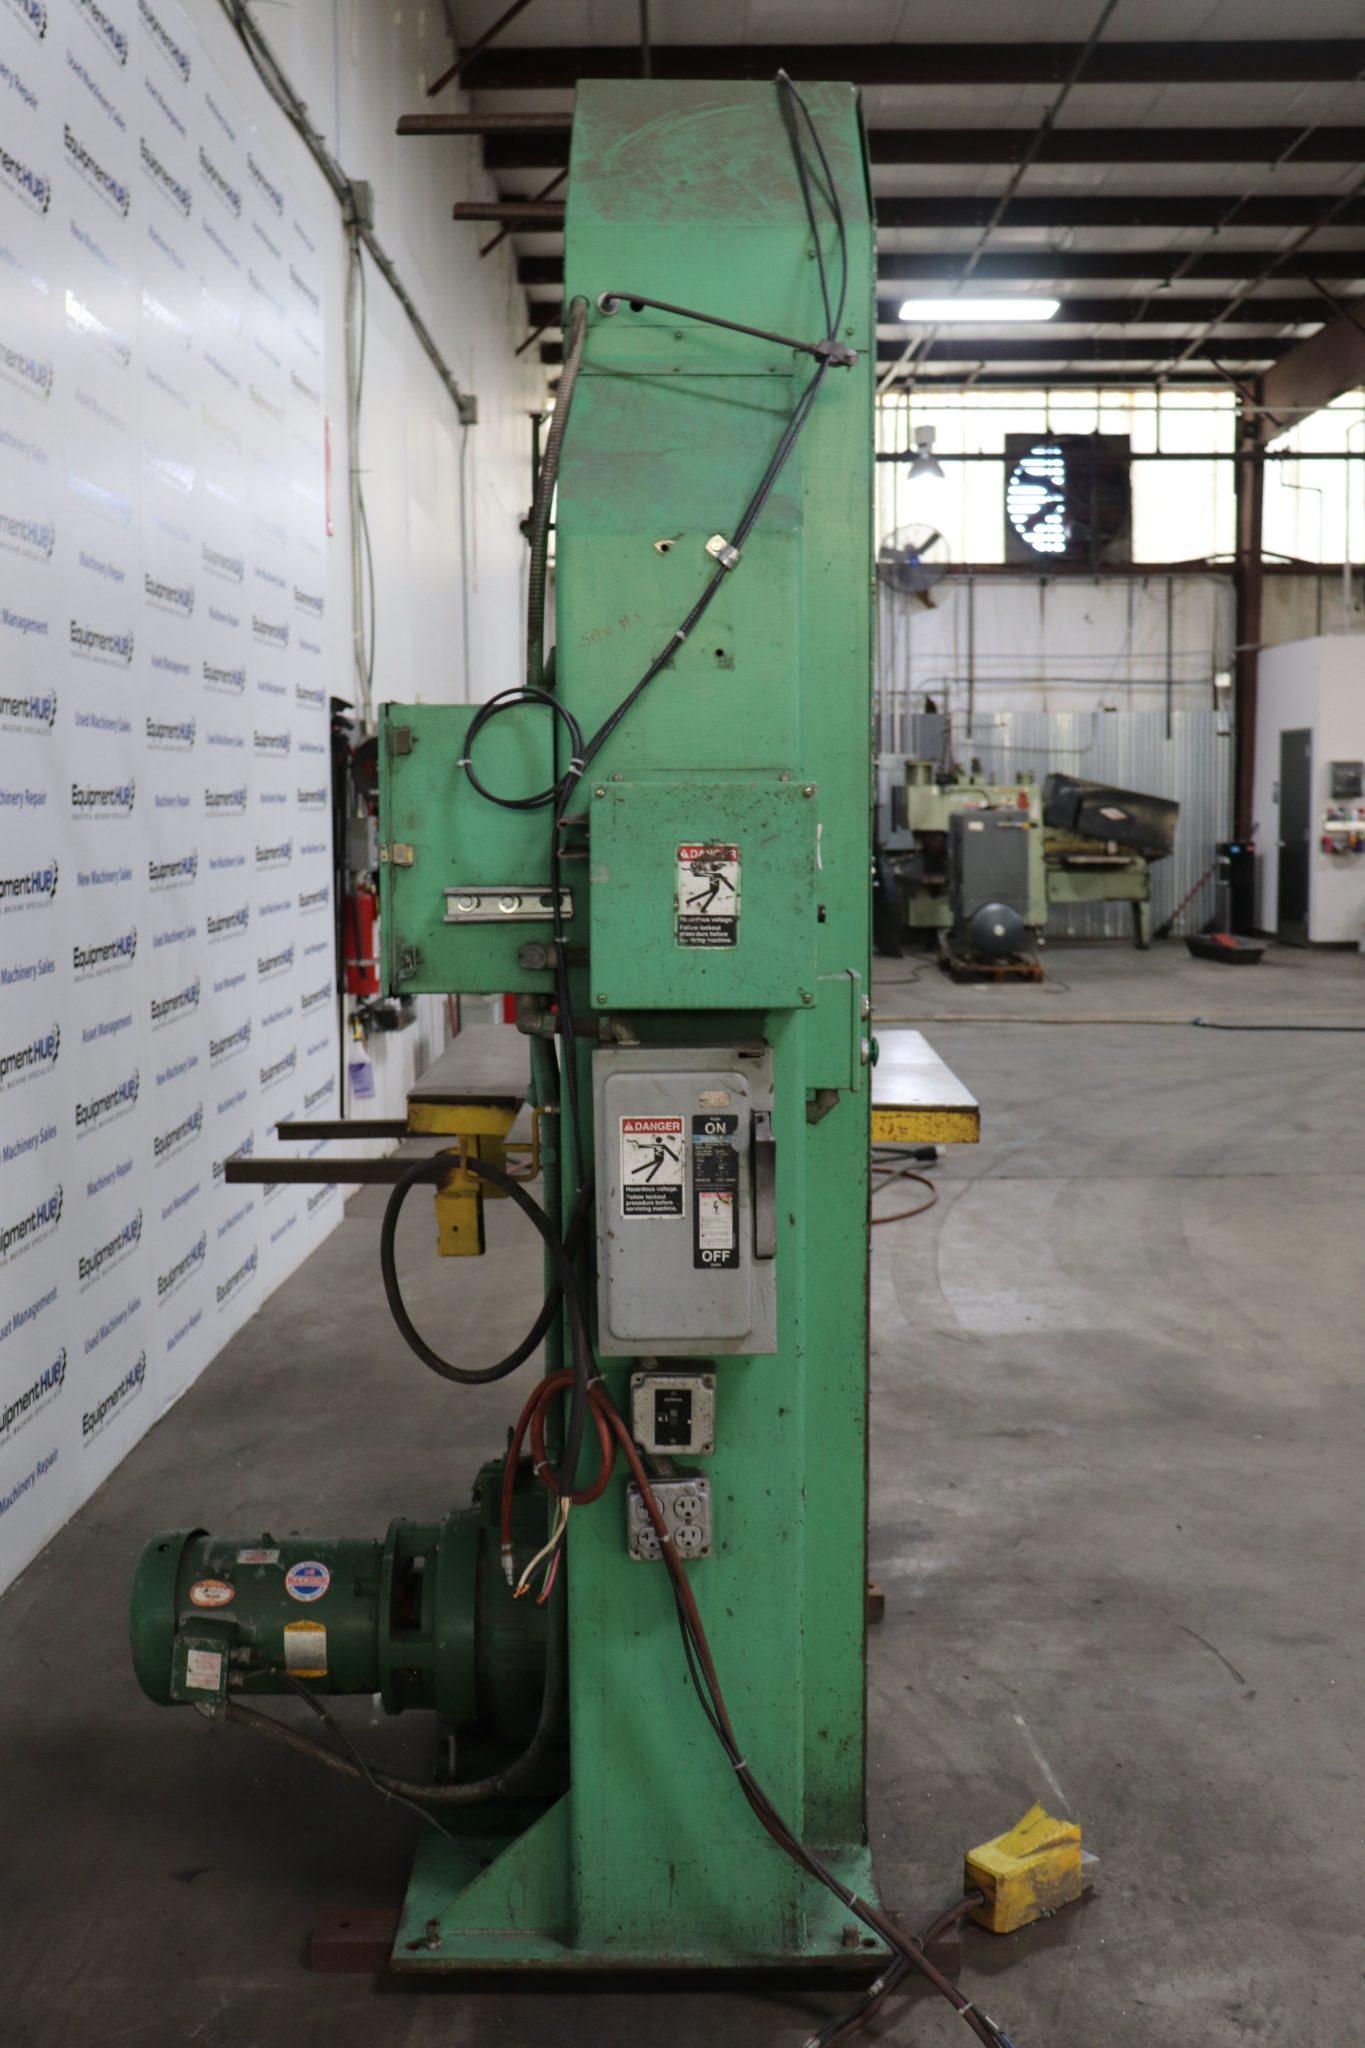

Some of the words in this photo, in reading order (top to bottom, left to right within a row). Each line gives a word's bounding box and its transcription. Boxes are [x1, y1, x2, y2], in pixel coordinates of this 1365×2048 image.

[70, 620, 129, 657] EquipmentHUB
[72, 784, 131, 811] EquipmentHUB
[73, 935, 132, 972] EquipmentHUB
[76, 1078, 136, 1128] EquipmentHUB
[634, 1121, 680, 1131] DANGER
[704, 1122, 726, 1134] ON
[2, 1132, 39, 1163] Machinery
[625, 1200, 654, 1208] procedure
[79, 1218, 139, 1281] EquipmentHUB
[702, 1250, 731, 1262] OFF
[12, 1286, 58, 1332] Management
[82, 1362, 143, 1437] EquipmentHUB
[36, 1447, 59, 1480] Repair
